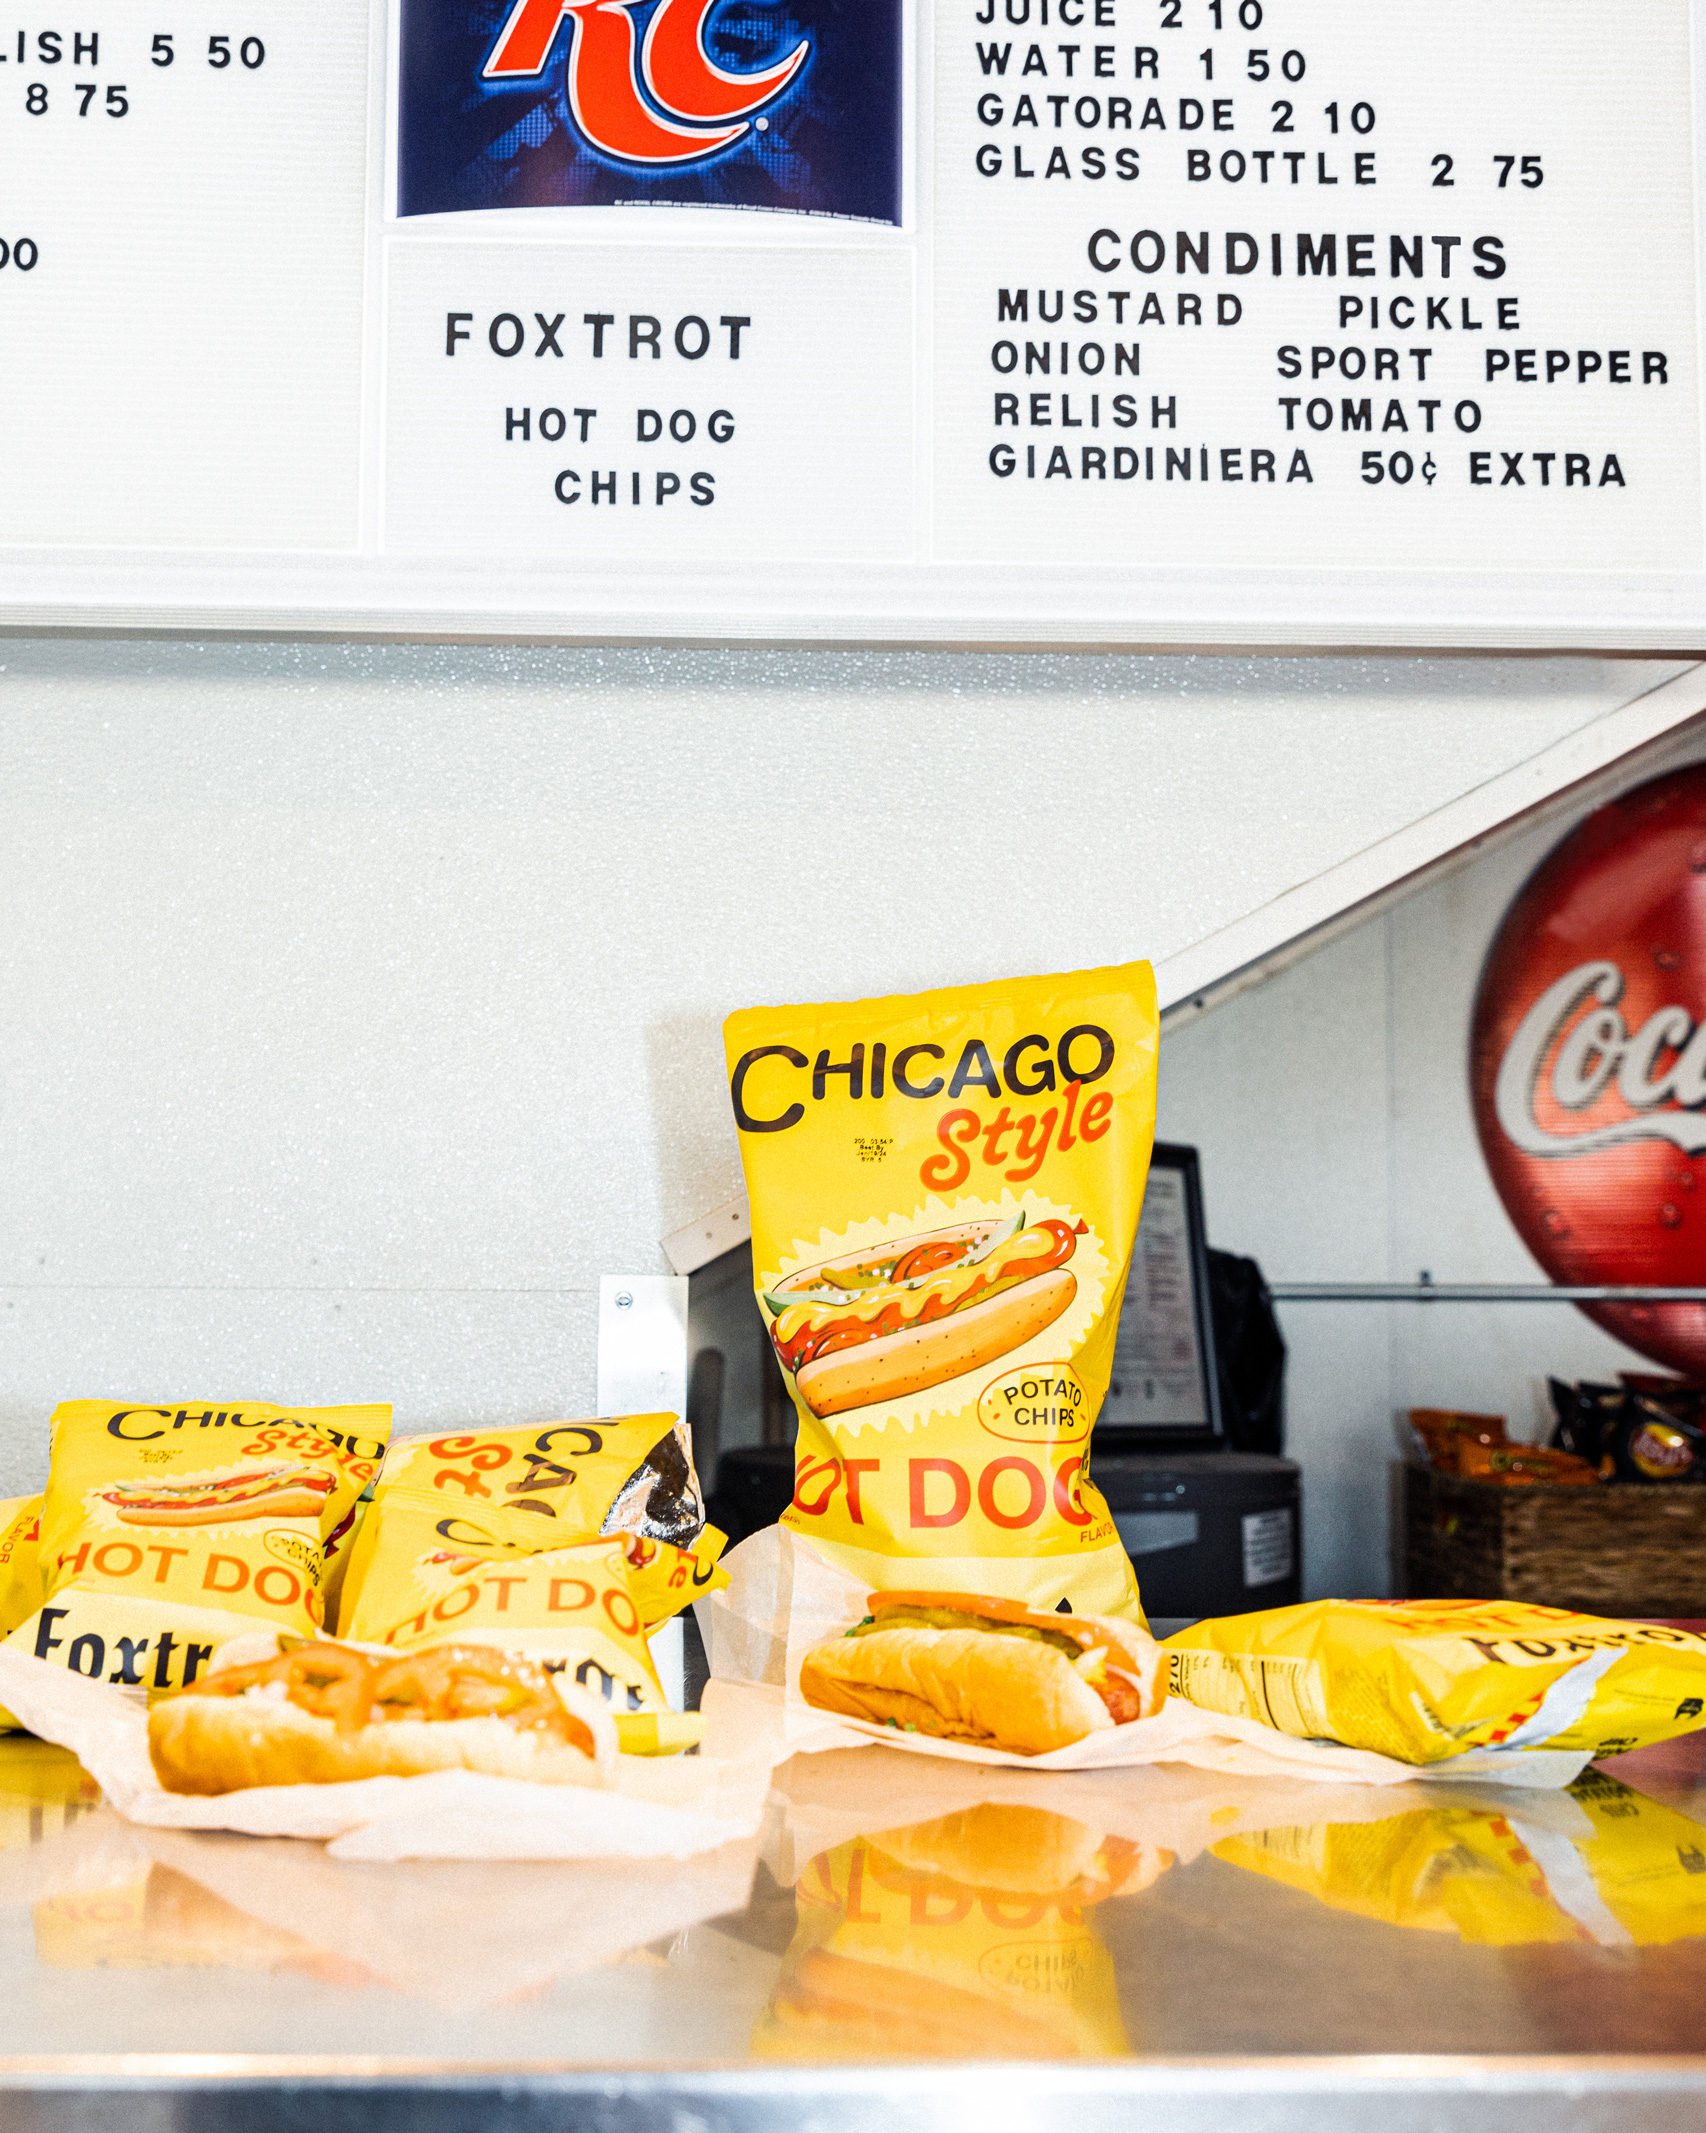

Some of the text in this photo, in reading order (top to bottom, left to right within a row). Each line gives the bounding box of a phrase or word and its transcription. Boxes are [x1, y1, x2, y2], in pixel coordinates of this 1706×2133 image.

[975, 0, 1263, 31] JUICE 2 10
[0, 30, 266, 70] ISH 5 50
[975, 42, 1306, 83] WATER 1 50
[25, 82, 129, 118] 8 75
[977, 92, 1376, 135] GATORADE 2 10
[975, 143, 1544, 189] GLASS BOTTLE 2 75
[1087, 228, 1507, 280] CONDIMENTS
[998, 288, 1520, 331] MUSTARD PICKLE
[446, 312, 751, 361] FOXTROT
[991, 340, 1668, 385] ONION SPORT PEPPER
[505, 407, 735, 444] HOT DOG
[994, 392, 1482, 434] RELISH TOMATO
[988, 443, 1626, 487] GIARDINIERA 50¢ EXTRA
[554, 469, 715, 506] CHIPS
[731, 1025, 1115, 1133] CHICAGO
[920, 1079, 1115, 1192] Style
[1003, 1379, 1082, 1407] POTATO
[1014, 1407, 1074, 1427] CHIPS
[0, 1516, 34, 1564] FLAVOR
[1079, 1522, 1114, 1543] FLAVO
[57, 1542, 188, 1583] HOT
